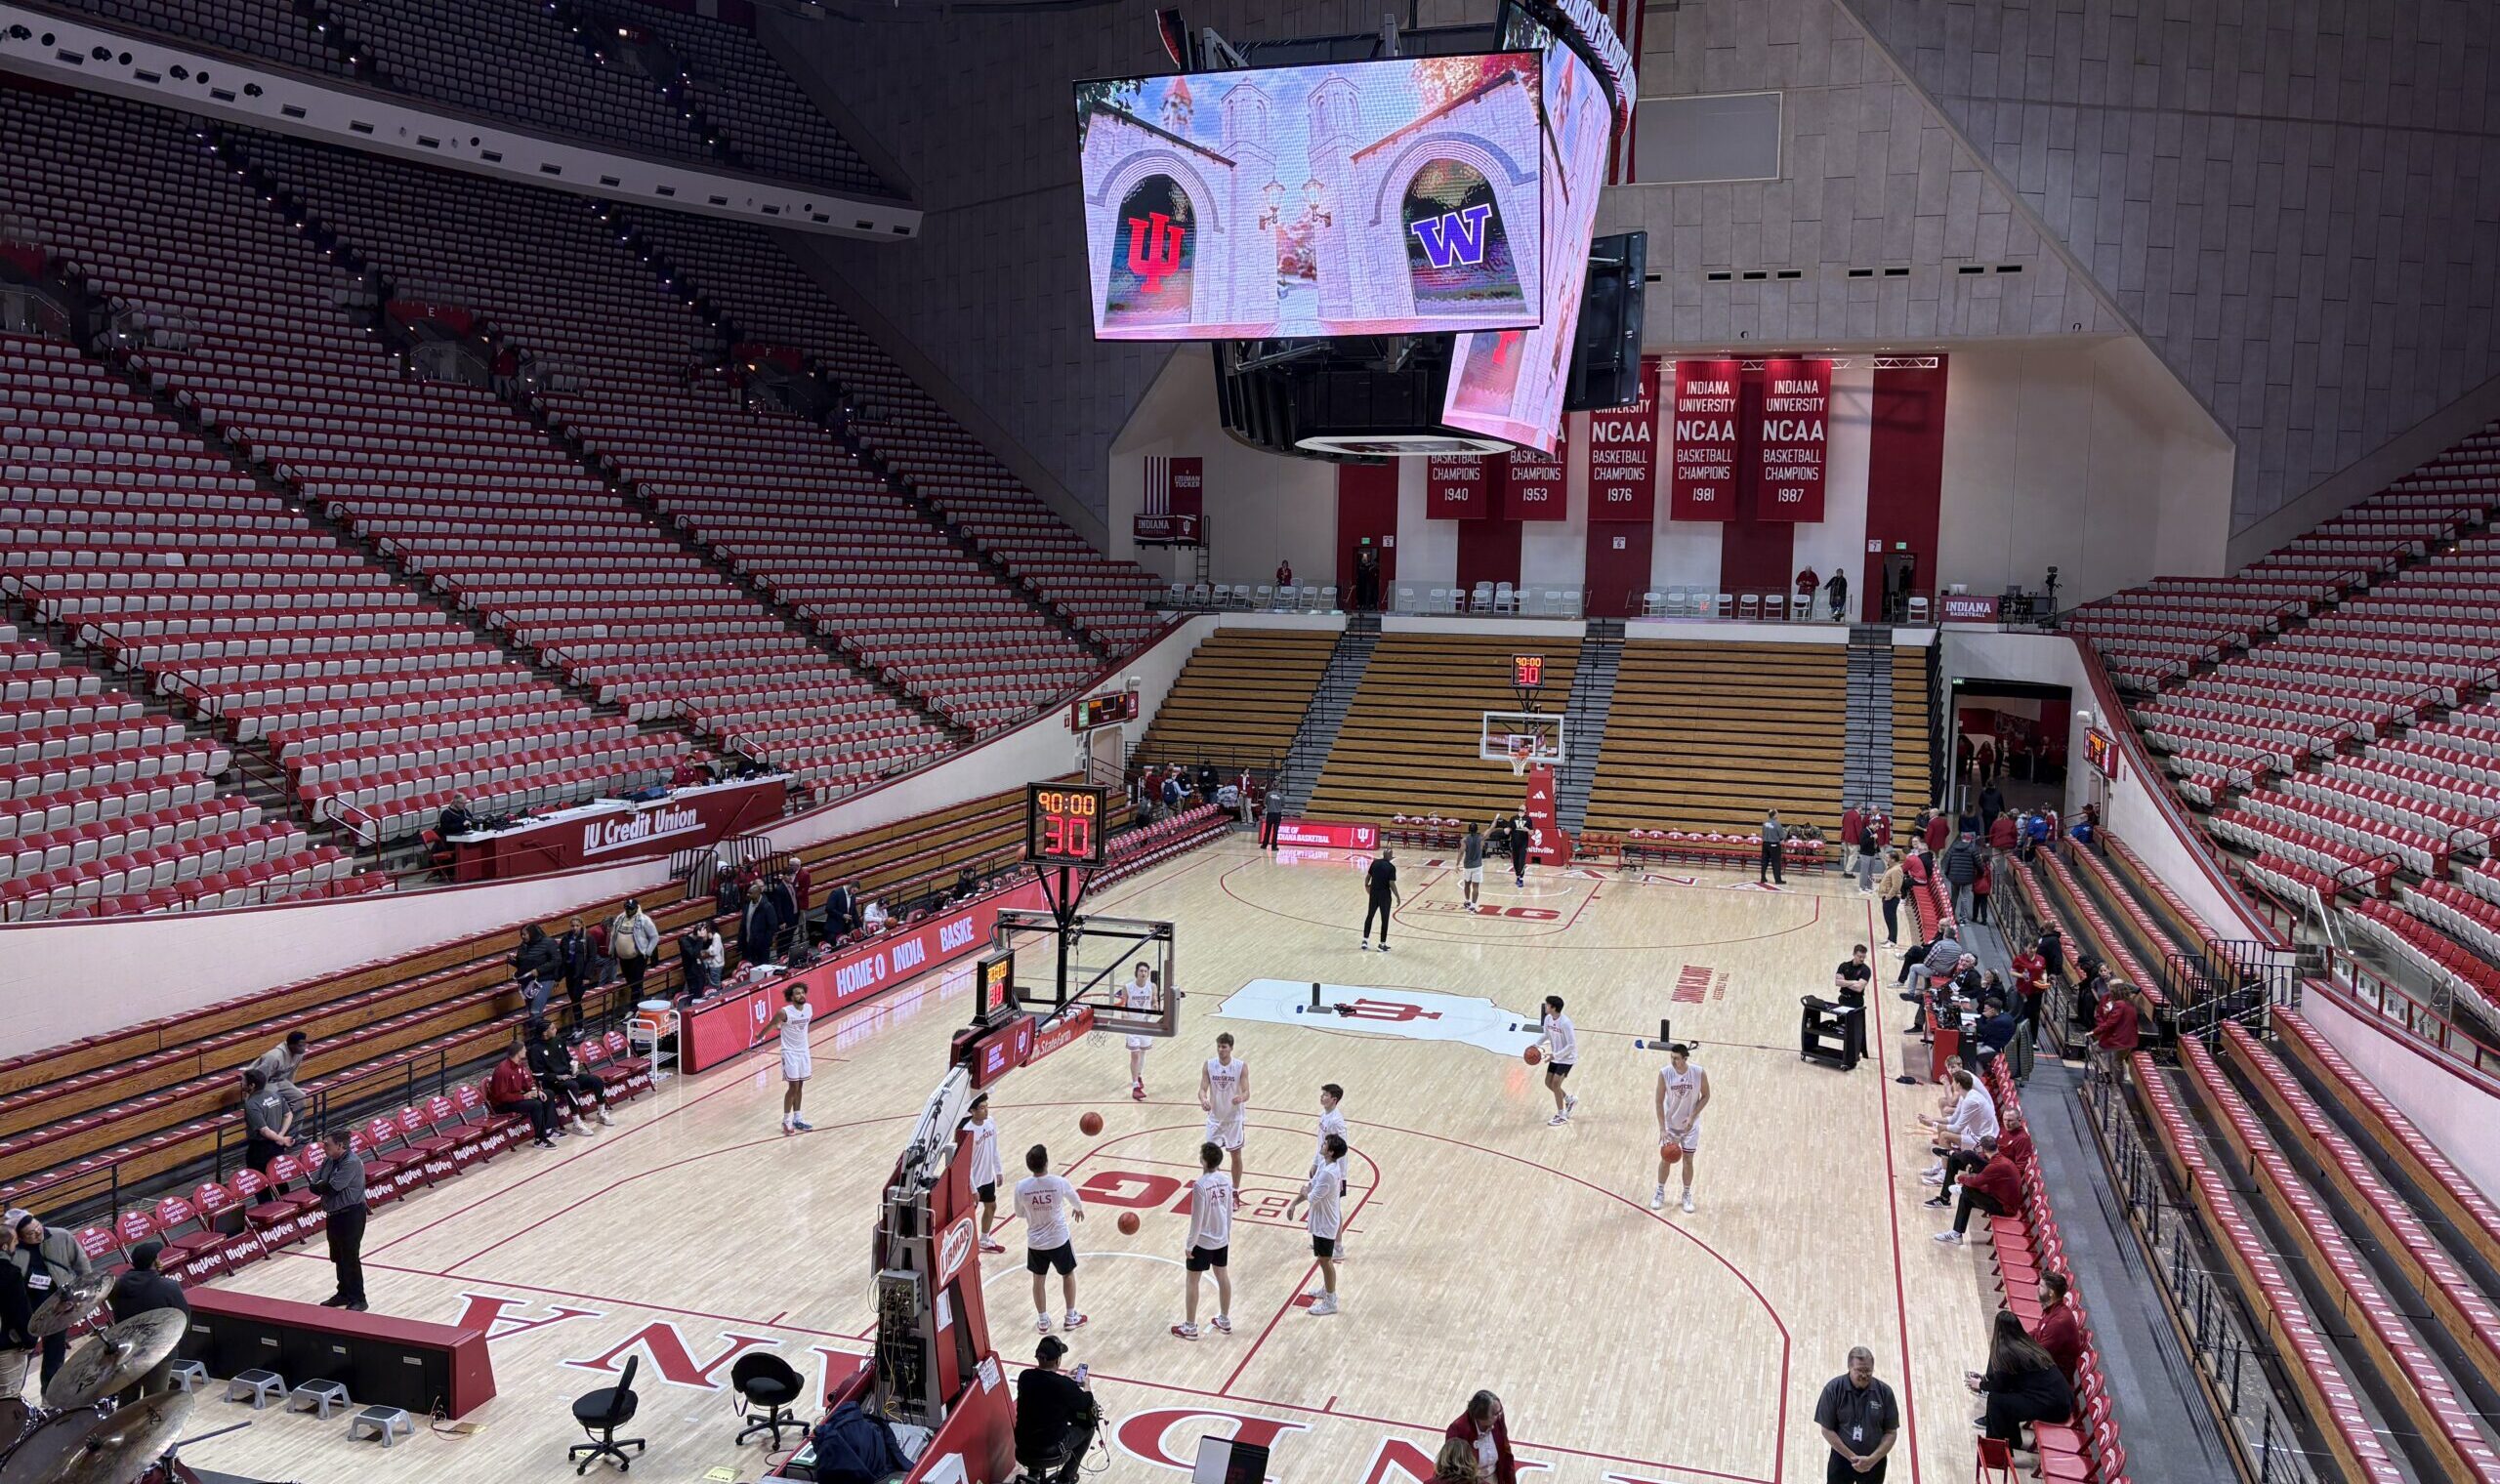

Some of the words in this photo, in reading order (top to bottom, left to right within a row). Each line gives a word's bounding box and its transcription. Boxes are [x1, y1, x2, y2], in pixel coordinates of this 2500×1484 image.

[1411, 204, 1492, 268] W
[428, 307, 437, 317] E
[766, 348, 772, 357] F
[1687, 381, 1729, 395] INDIANA
[1773, 380, 1819, 394] INDIANA
[1679, 398, 1736, 413] UNIVERSITY
[1766, 397, 1825, 412] UNIVERSITY
[1592, 421, 1650, 442] NCAA
[1676, 420, 1735, 441] NCAA
[1763, 420, 1824, 441] NCAA
[1593, 450, 1647, 464] BASKETBALL
[1677, 449, 1732, 463] BASKETBALL
[1763, 449, 1821, 463] BASKETBALL
[1433, 468, 1479, 480] CHAMPIONS
[1512, 467, 1562, 480] CHAMPIONS
[1594, 467, 1645, 480] CHAMPIONS
[1678, 467, 1729, 479] CHAMPIONS
[1765, 467, 1818, 480] CHAMPIONS
[1444, 488, 1469, 501] 1940
[1523, 488, 1548, 501] 1953
[1607, 488, 1632, 501] 1976
[1692, 488, 1714, 502] 1981
[1778, 488, 1804, 502] 1987
[1138, 519, 1170, 529] INDIANA
[1945, 601, 1991, 613] INDIANA
[1515, 657, 1541, 667] 90:00
[1519, 667, 1538, 683] 30
[1038, 792, 1095, 815] 90:00
[583, 822, 601, 850] IU
[604, 811, 651, 845] Credit
[654, 804, 697, 834] Union
[1515, 819, 1526, 829] W
[1045, 815, 1088, 855] 30
[835, 960, 875, 998] HOME
[893, 937, 925, 973] INDIA
[939, 916, 975, 953] BASKE
[627, 1074, 647, 1088] HyVee
[507, 1123, 531, 1137] HyVee
[480, 1134, 505, 1151] HyVee
[453, 1144, 479, 1161] HyVee
[273, 1159, 293, 1171] German
[276, 1164, 297, 1175] American
[425, 1160, 452, 1175] HyVee
[236, 1174, 256, 1184] German
[281, 1172, 292, 1180] Bank
[395, 1168, 422, 1185] HyVee
[238, 1177, 261, 1190] American
[244, 1185, 257, 1195] Bank
[200, 1187, 221, 1199] German
[202, 1192, 225, 1205] American
[1031, 1194, 1052, 1205] ALS
[162, 1202, 184, 1214] German
[207, 1200, 220, 1209] Bank
[165, 1207, 188, 1219] American
[171, 1215, 184, 1224] Bank
[124, 1216, 146, 1228] German
[125, 1222, 149, 1235] American
[82, 1232, 105, 1246] German
[131, 1231, 144, 1240] Bank
[261, 1223, 295, 1243] HyVee
[85, 1237, 109, 1253] American
[226, 1240, 259, 1260] HyVee
[940, 1222, 971, 1279] LIBMAN
[90, 1247, 104, 1257] Bank
[187, 1254, 223, 1275] HyVee
